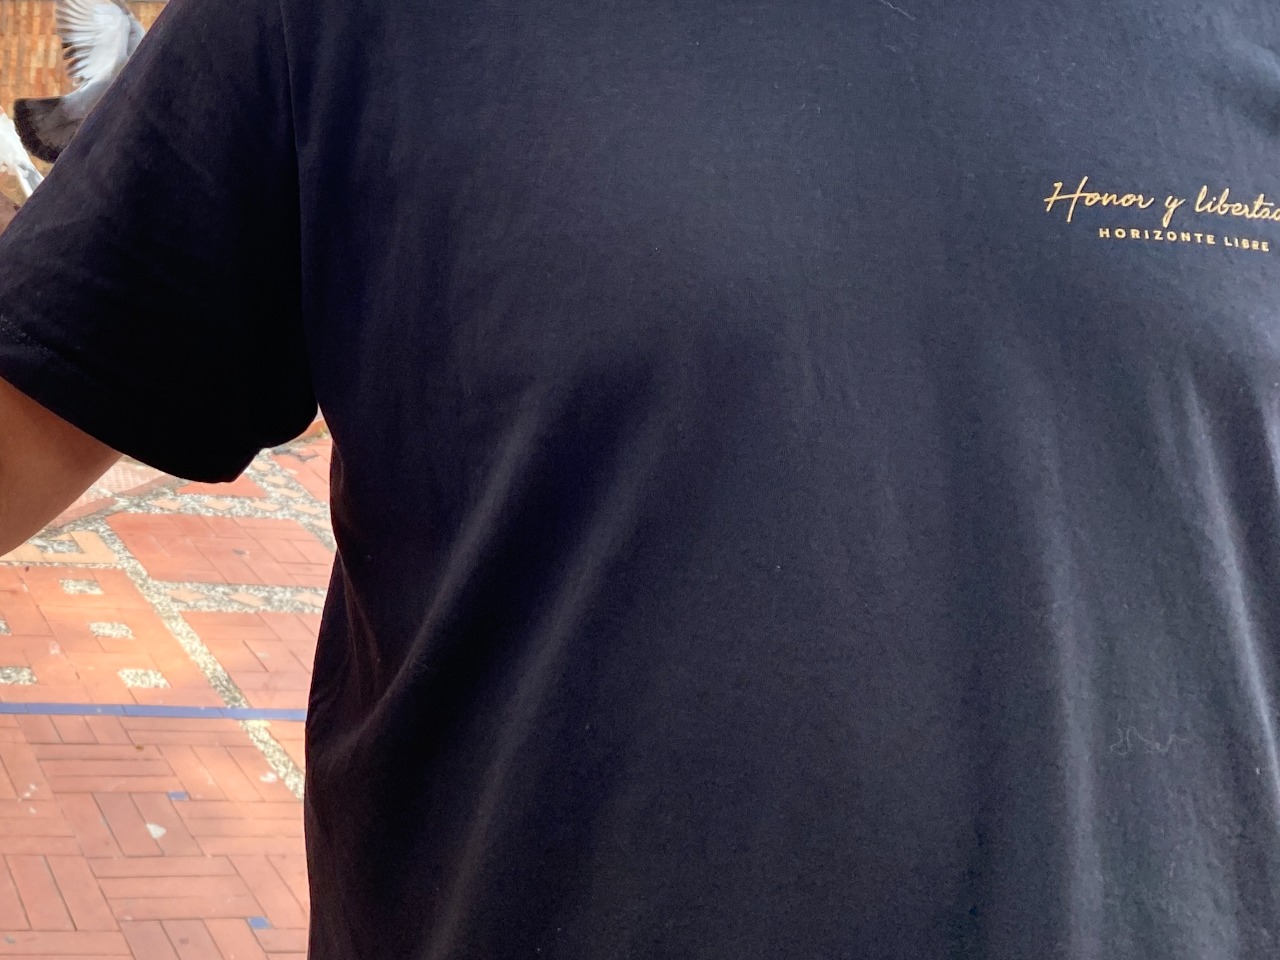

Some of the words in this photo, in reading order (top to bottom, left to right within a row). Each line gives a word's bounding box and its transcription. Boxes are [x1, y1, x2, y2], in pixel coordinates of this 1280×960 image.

[1043, 175, 1155, 223] Honor
[1161, 195, 1187, 228] y
[1098, 227, 1216, 245] HORIZONTE
[1223, 236, 1270, 253] LIBRE
